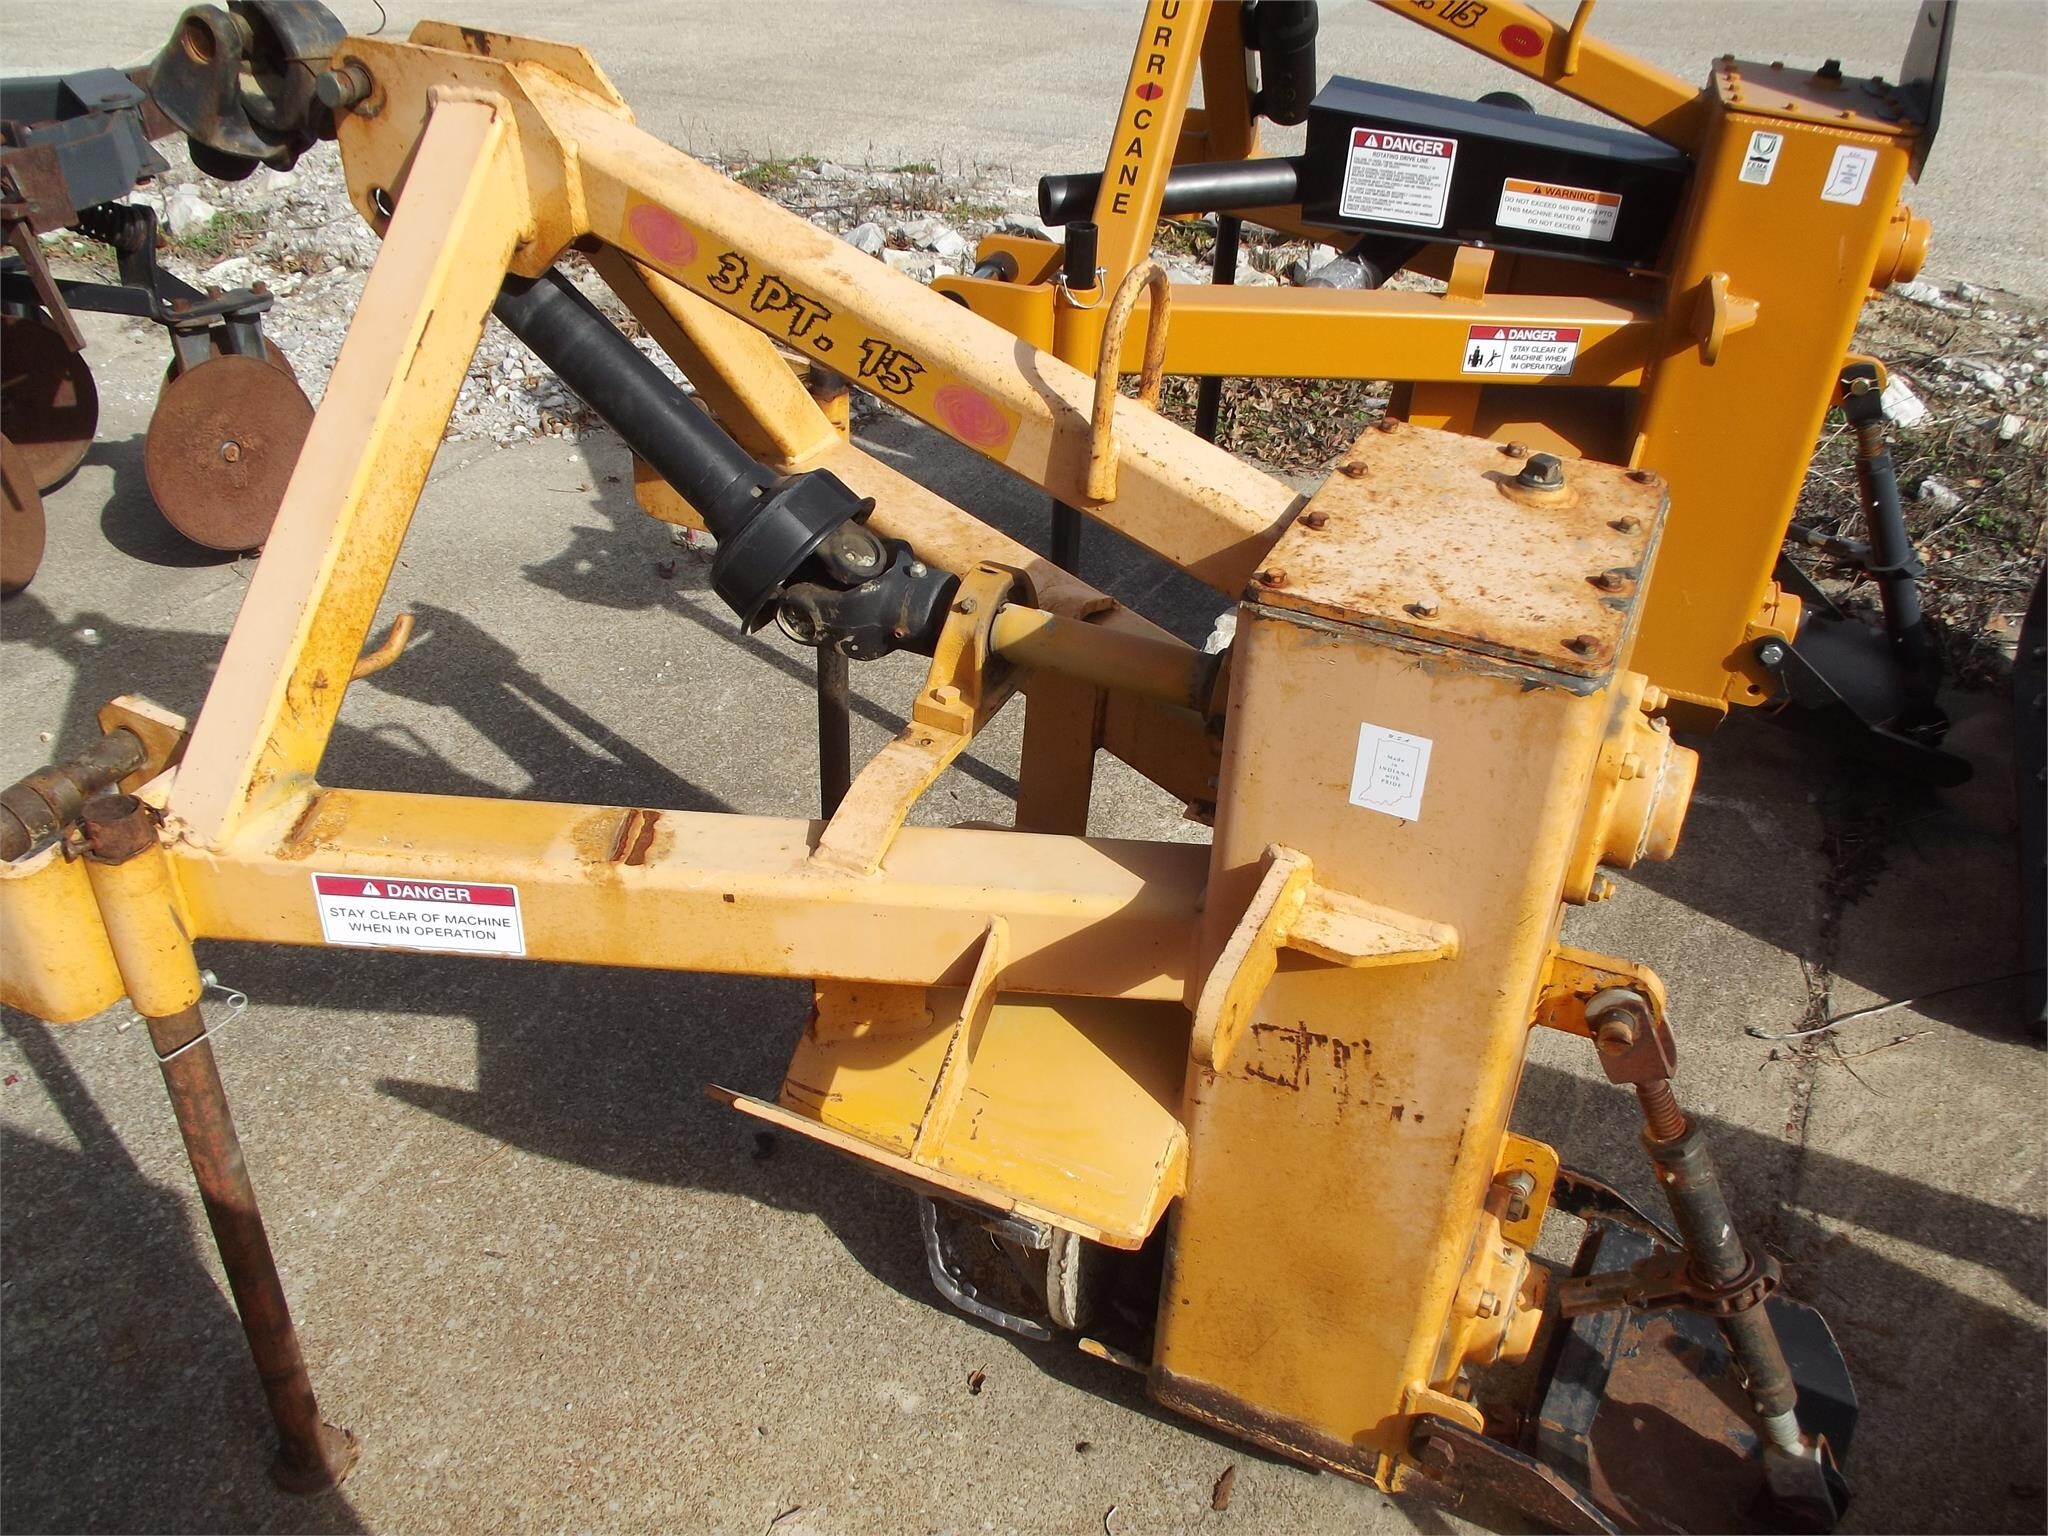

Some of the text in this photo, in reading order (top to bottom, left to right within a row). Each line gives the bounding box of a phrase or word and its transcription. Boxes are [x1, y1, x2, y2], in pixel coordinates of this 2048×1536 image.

[1382, 136, 1444, 156] DANGER
[1372, 151, 1399, 160] ROTATING
[1545, 187, 1596, 202] WARNING
[1531, 200, 1558, 209] EXCEED
[1571, 205, 1587, 213] RPM
[1522, 208, 1553, 218] MACHINE
[1554, 213, 1576, 221] RATED
[707, 251, 927, 395] 3 PT. 15
[1508, 329, 1558, 341] DANGER
[1512, 345, 1568, 354] STAY CLEAR OF
[1510, 354, 1567, 363] MACHINE WHEN
[1520, 363, 1562, 371] OPERATION
[386, 884, 472, 902] DANGER
[329, 907, 512, 928] STAY CLEAR OF MACHINE
[348, 922, 497, 940] WHEN IN OPERATION
